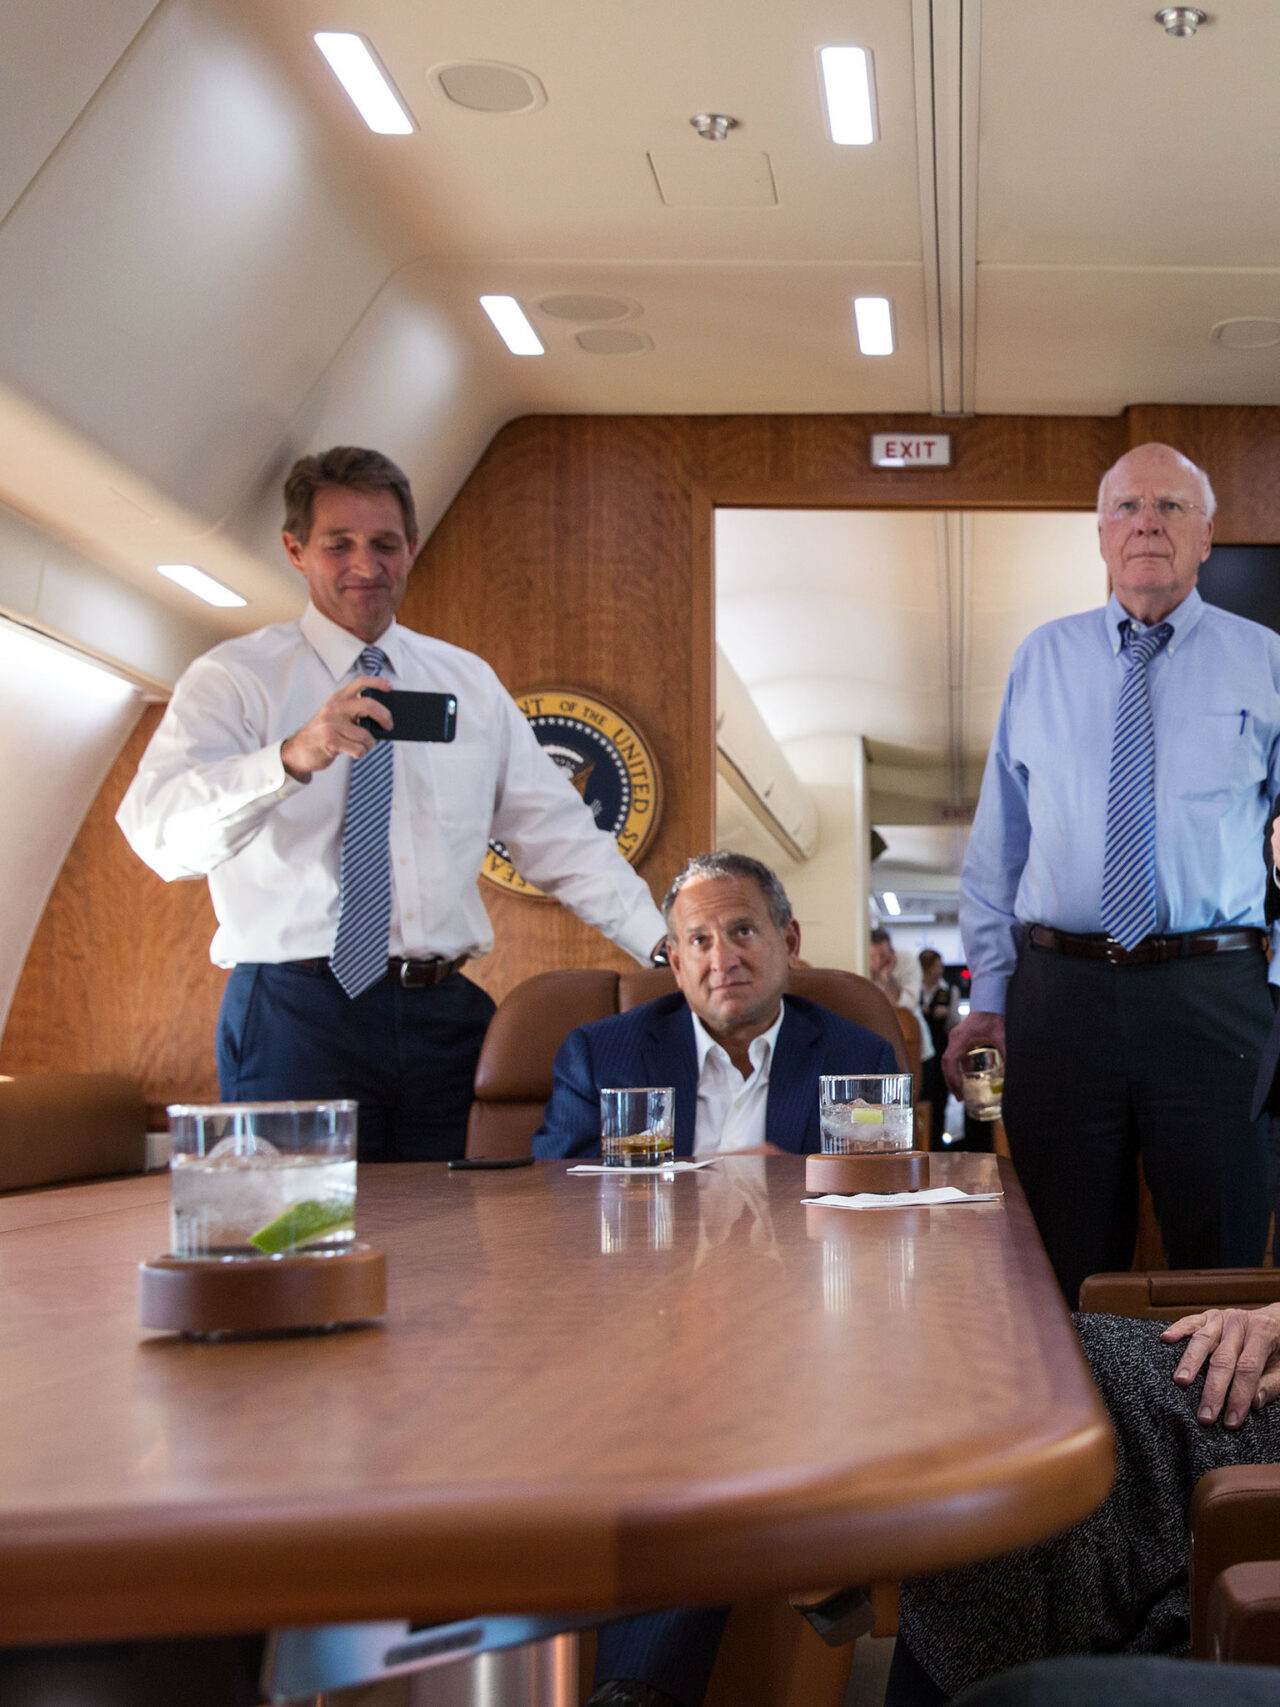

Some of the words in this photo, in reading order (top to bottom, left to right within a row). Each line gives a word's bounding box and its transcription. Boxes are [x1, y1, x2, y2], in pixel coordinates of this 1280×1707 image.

[885, 441, 936, 459] EXIT
[560, 700, 577, 713] OF
[583, 706, 607, 726] THE
[613, 728, 650, 814] UNITED
